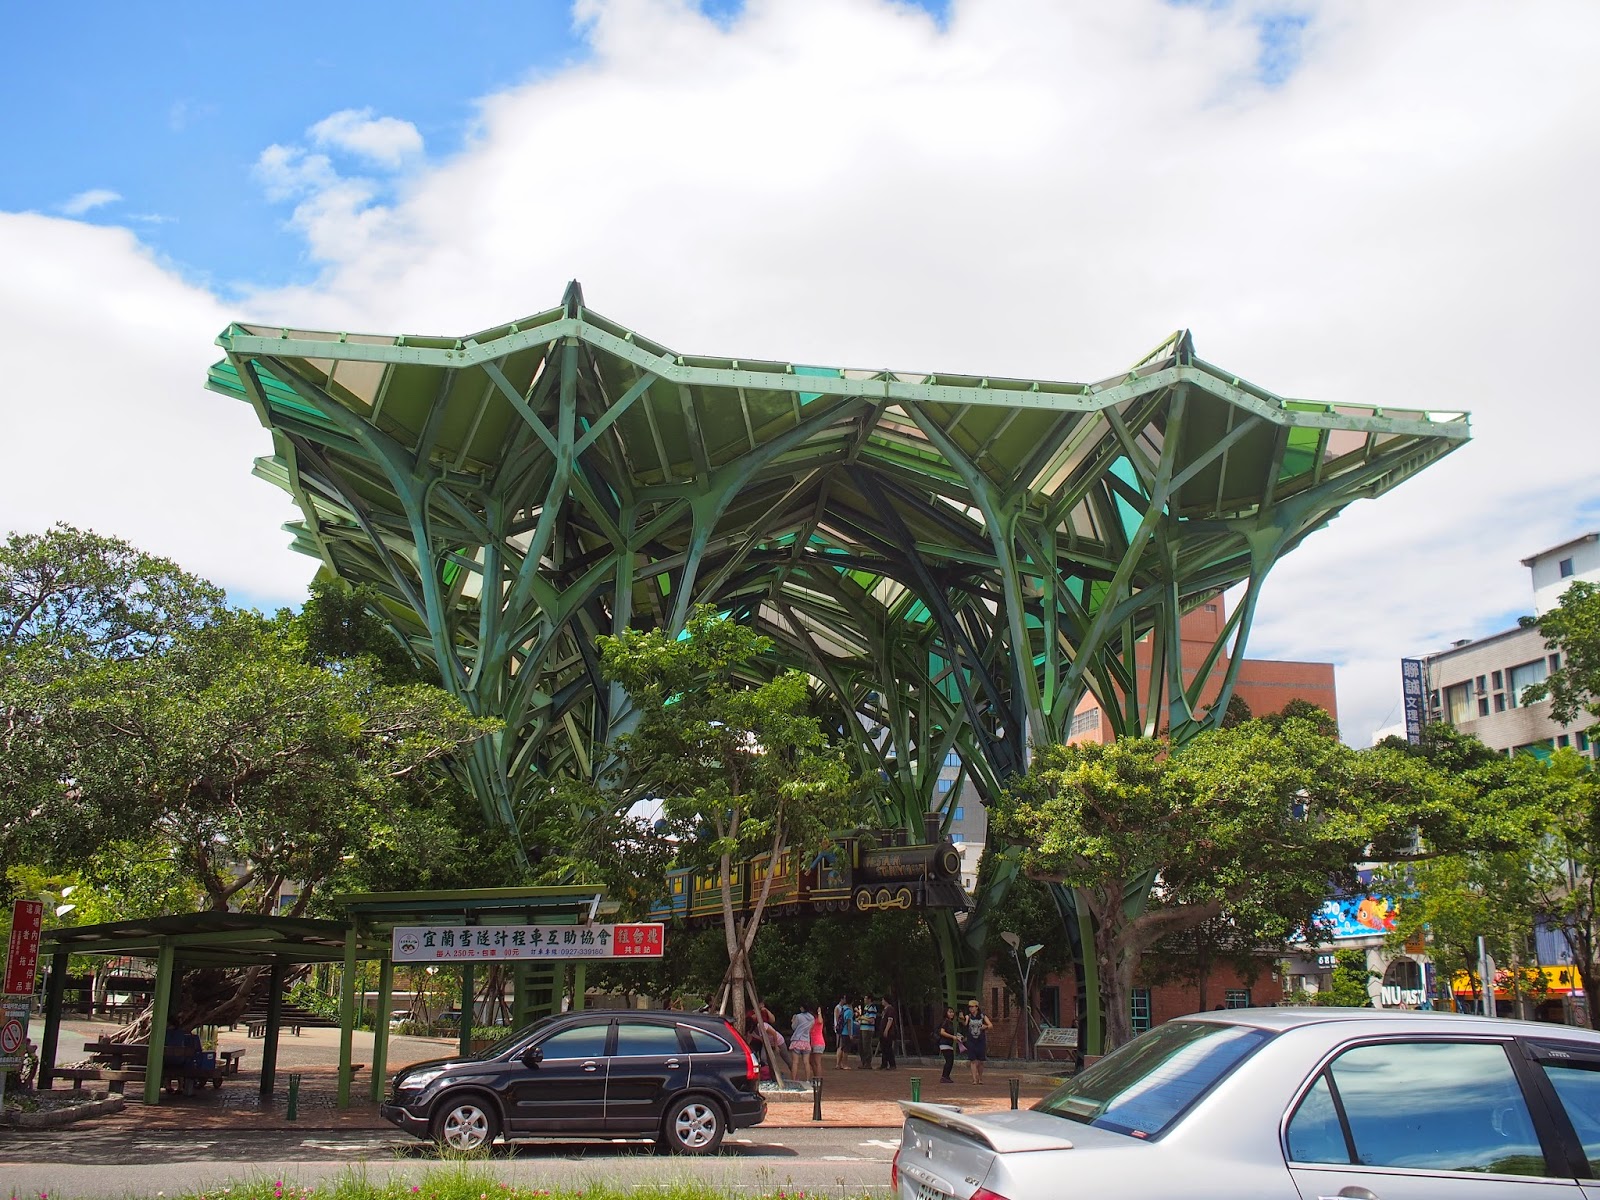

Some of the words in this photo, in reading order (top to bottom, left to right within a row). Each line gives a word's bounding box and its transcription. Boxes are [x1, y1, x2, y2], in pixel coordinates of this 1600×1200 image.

[25, 904, 41, 991] 廣場內禁止停車
[423, 929, 612, 948] 宜蘭雪隧計程車互助協會
[1381, 985, 1401, 1005] NU
